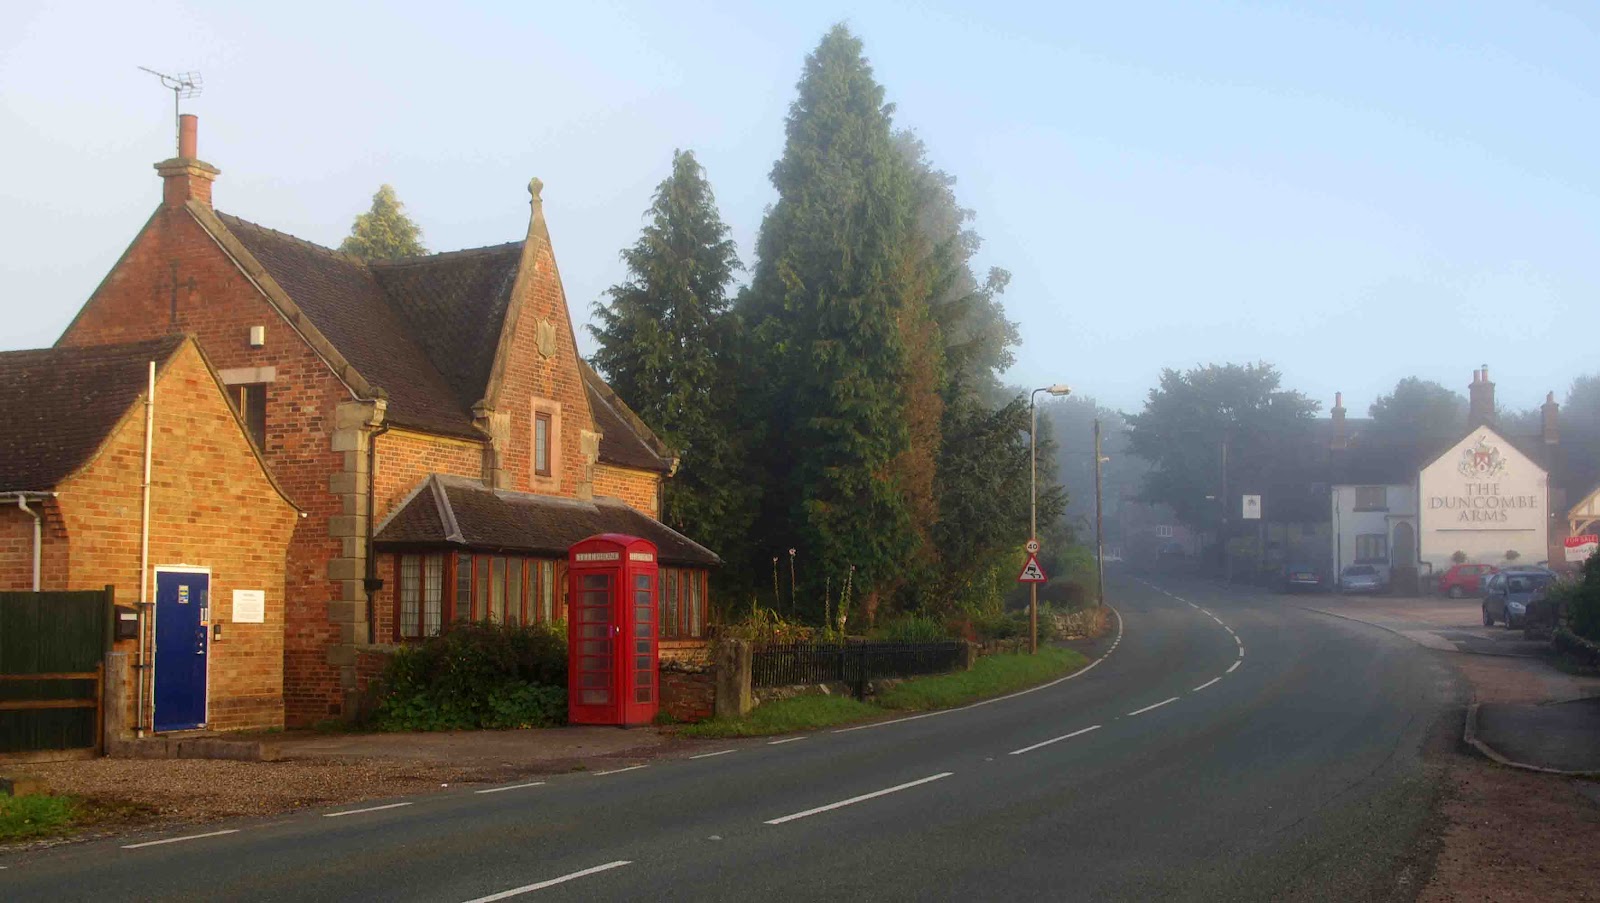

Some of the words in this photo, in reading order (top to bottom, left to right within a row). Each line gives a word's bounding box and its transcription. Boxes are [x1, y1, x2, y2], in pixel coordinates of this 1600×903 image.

[1465, 483, 1500, 495] THE
[1430, 496, 1538, 509] DUNCOMBE
[1459, 510, 1508, 522] ARMS
[1580, 535, 1597, 543] SALE
